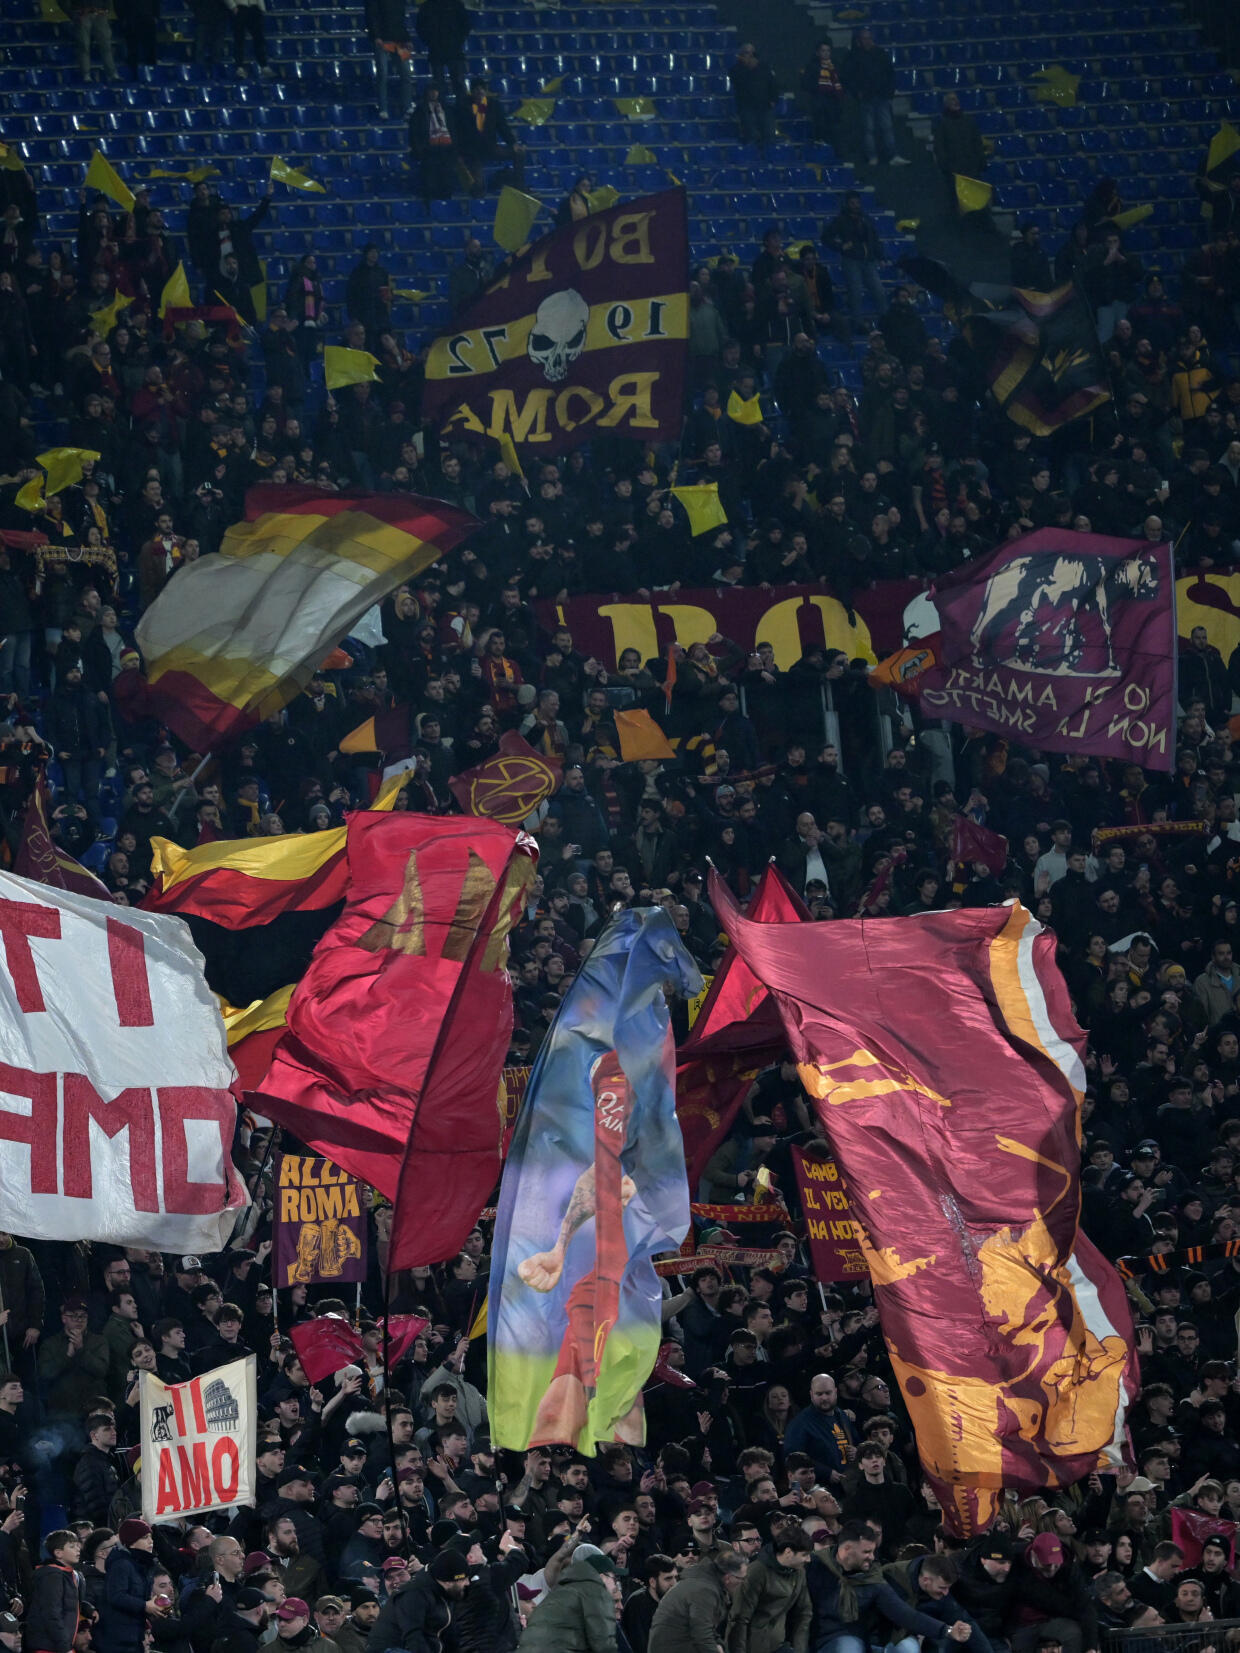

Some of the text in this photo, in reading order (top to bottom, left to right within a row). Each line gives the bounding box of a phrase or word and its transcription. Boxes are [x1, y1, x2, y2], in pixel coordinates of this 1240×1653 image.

[281, 1184, 360, 1222] ROMA
[164, 1376, 208, 1437] TI
[156, 1436, 240, 1515] AMO
